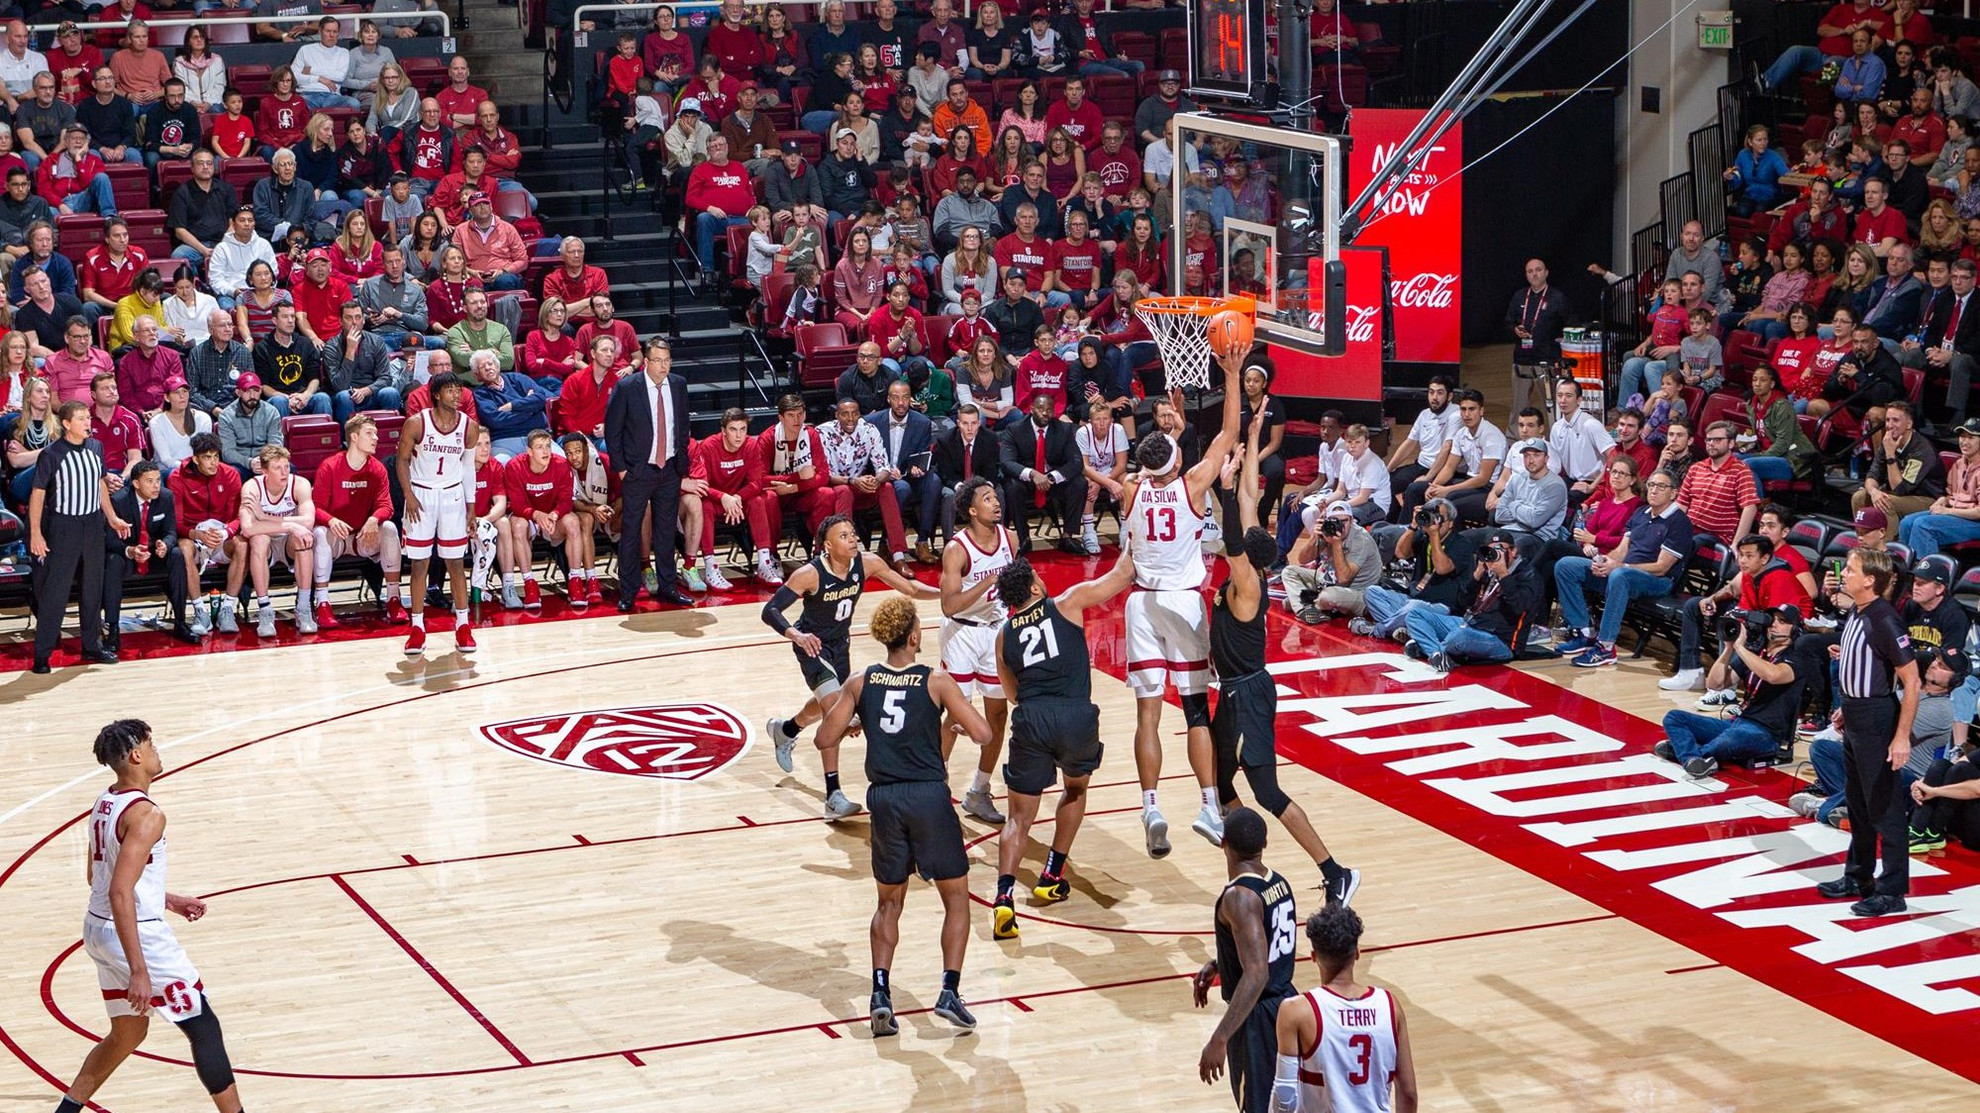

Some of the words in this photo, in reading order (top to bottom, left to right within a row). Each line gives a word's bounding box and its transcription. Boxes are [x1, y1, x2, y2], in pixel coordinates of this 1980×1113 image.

[1219, 13, 1243, 74] 14
[1705, 27, 1727, 45] EXIT
[880, 44, 895, 67] 6
[1374, 188, 1431, 217] NOW
[423, 444, 462, 455] STANFORD
[428, 436, 435, 445] C
[436, 456, 445, 476] 1
[1141, 490, 1153, 503] DA
[1154, 490, 1178, 503] SILVA
[1145, 507, 1177, 542] 13
[834, 598, 854, 622] 0
[1011, 605, 1045, 630] BATTEY
[1018, 617, 1061, 668] 21
[869, 671, 923, 688] SCHWARTZ
[879, 690, 907, 734] 5
[1268, 899, 1297, 964] 25
[1338, 1009, 1376, 1028] TERRY
[1348, 1034, 1373, 1086] 3
